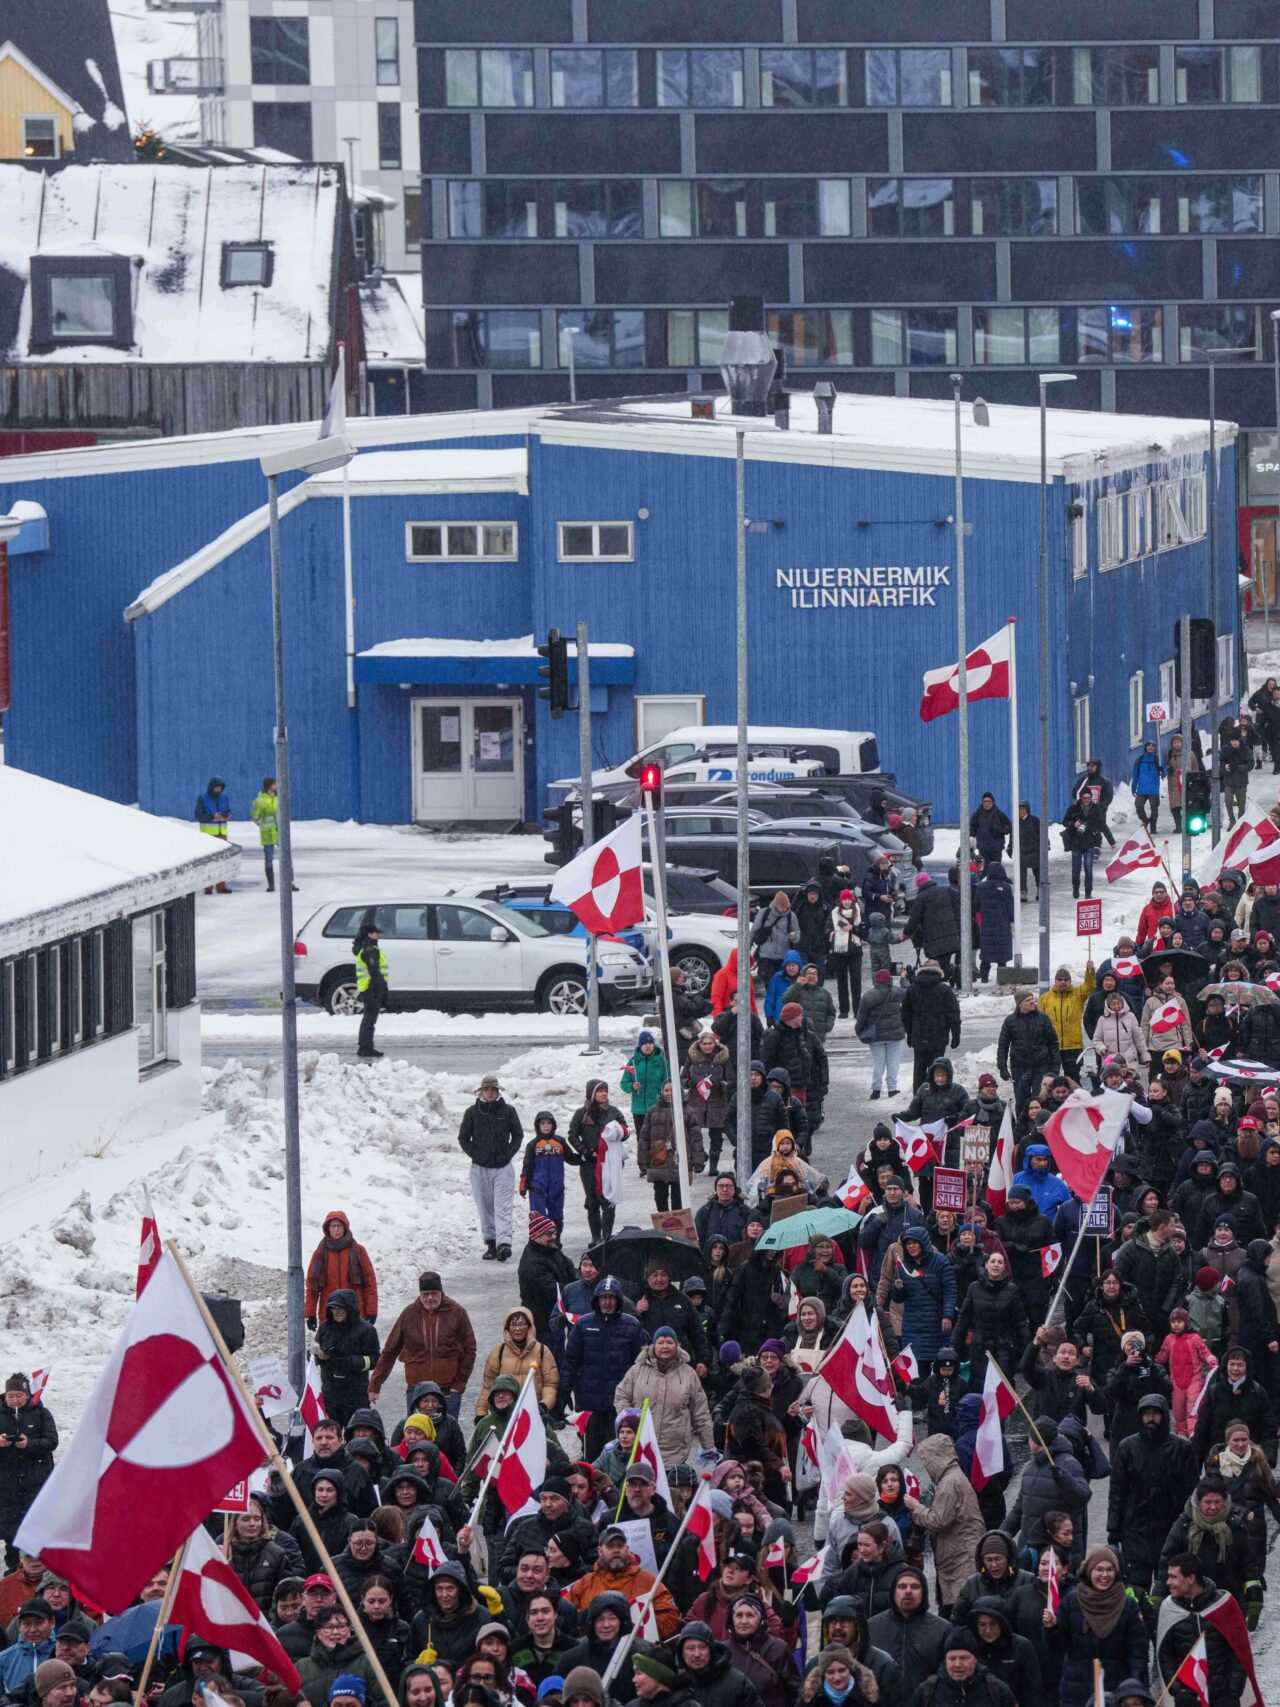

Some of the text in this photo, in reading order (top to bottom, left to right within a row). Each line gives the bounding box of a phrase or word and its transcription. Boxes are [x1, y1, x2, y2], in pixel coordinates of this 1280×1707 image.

[776, 566, 950, 587] NIUERNERMIK
[791, 587, 936, 608] ILINNIARFIK
[1079, 919, 1099, 929] SALE!
[965, 1145, 990, 1161] NO!
[938, 1194, 962, 1207] SALE!
